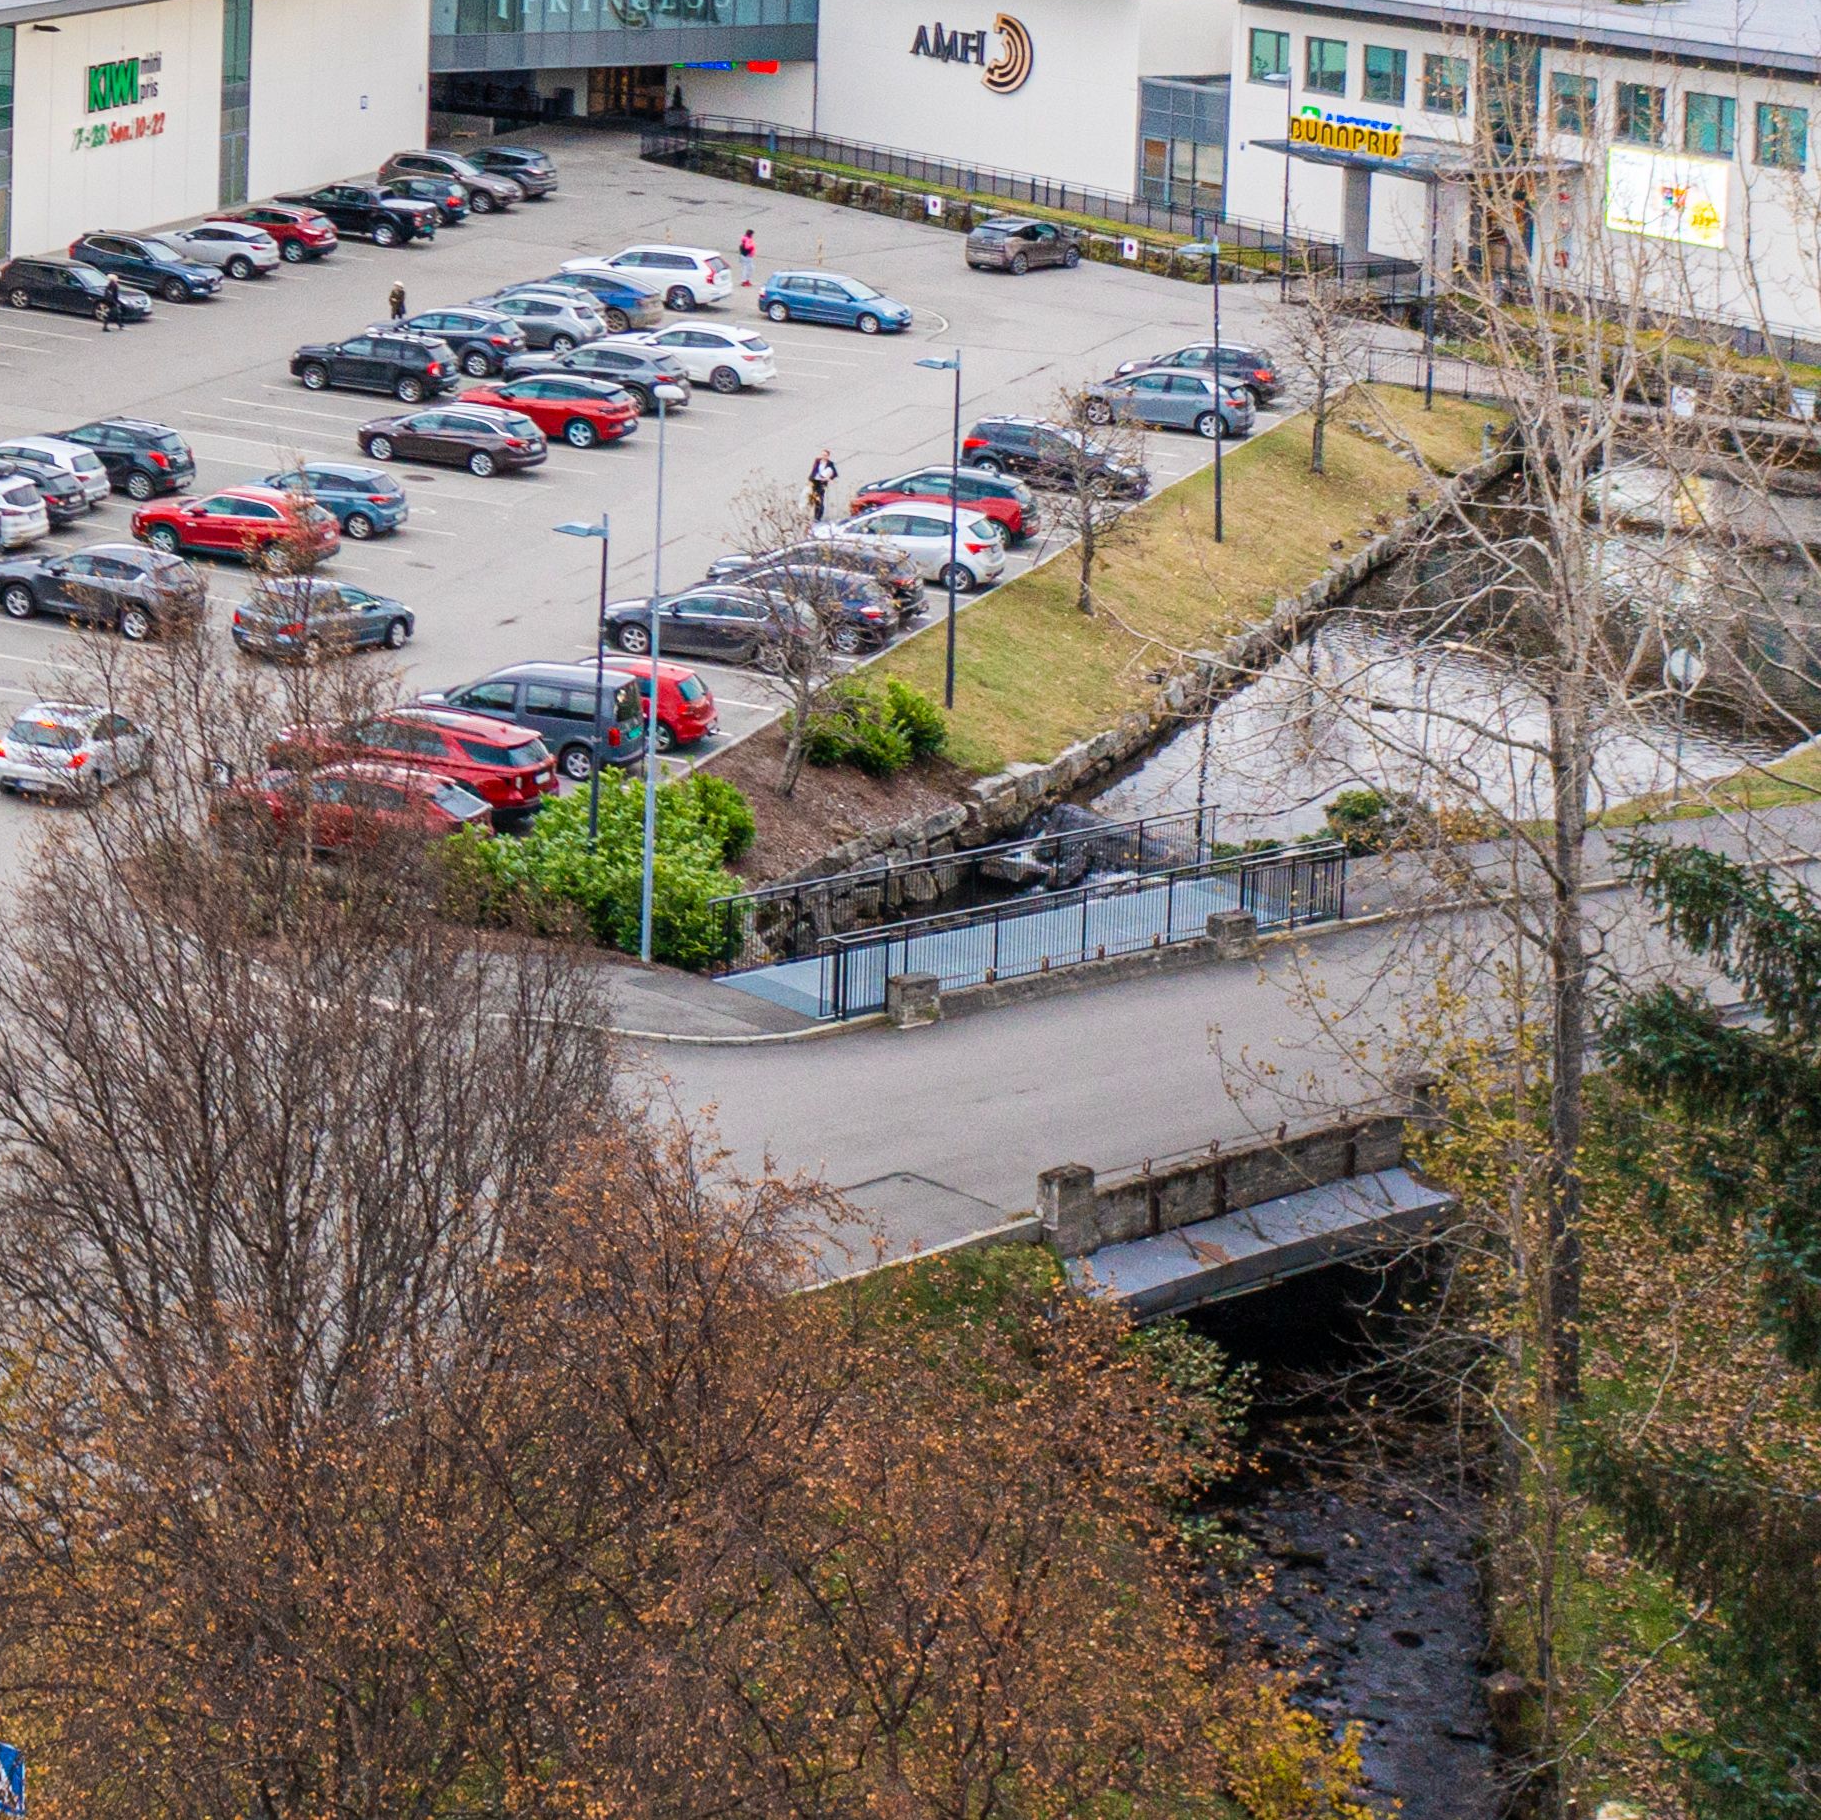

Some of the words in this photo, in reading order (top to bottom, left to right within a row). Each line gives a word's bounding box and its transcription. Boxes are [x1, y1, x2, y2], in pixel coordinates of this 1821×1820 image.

[909, 21, 987, 67] AMFI
[87, 56, 139, 113] KIWI
[1290, 117, 1401, 158] BUNNPRIS
